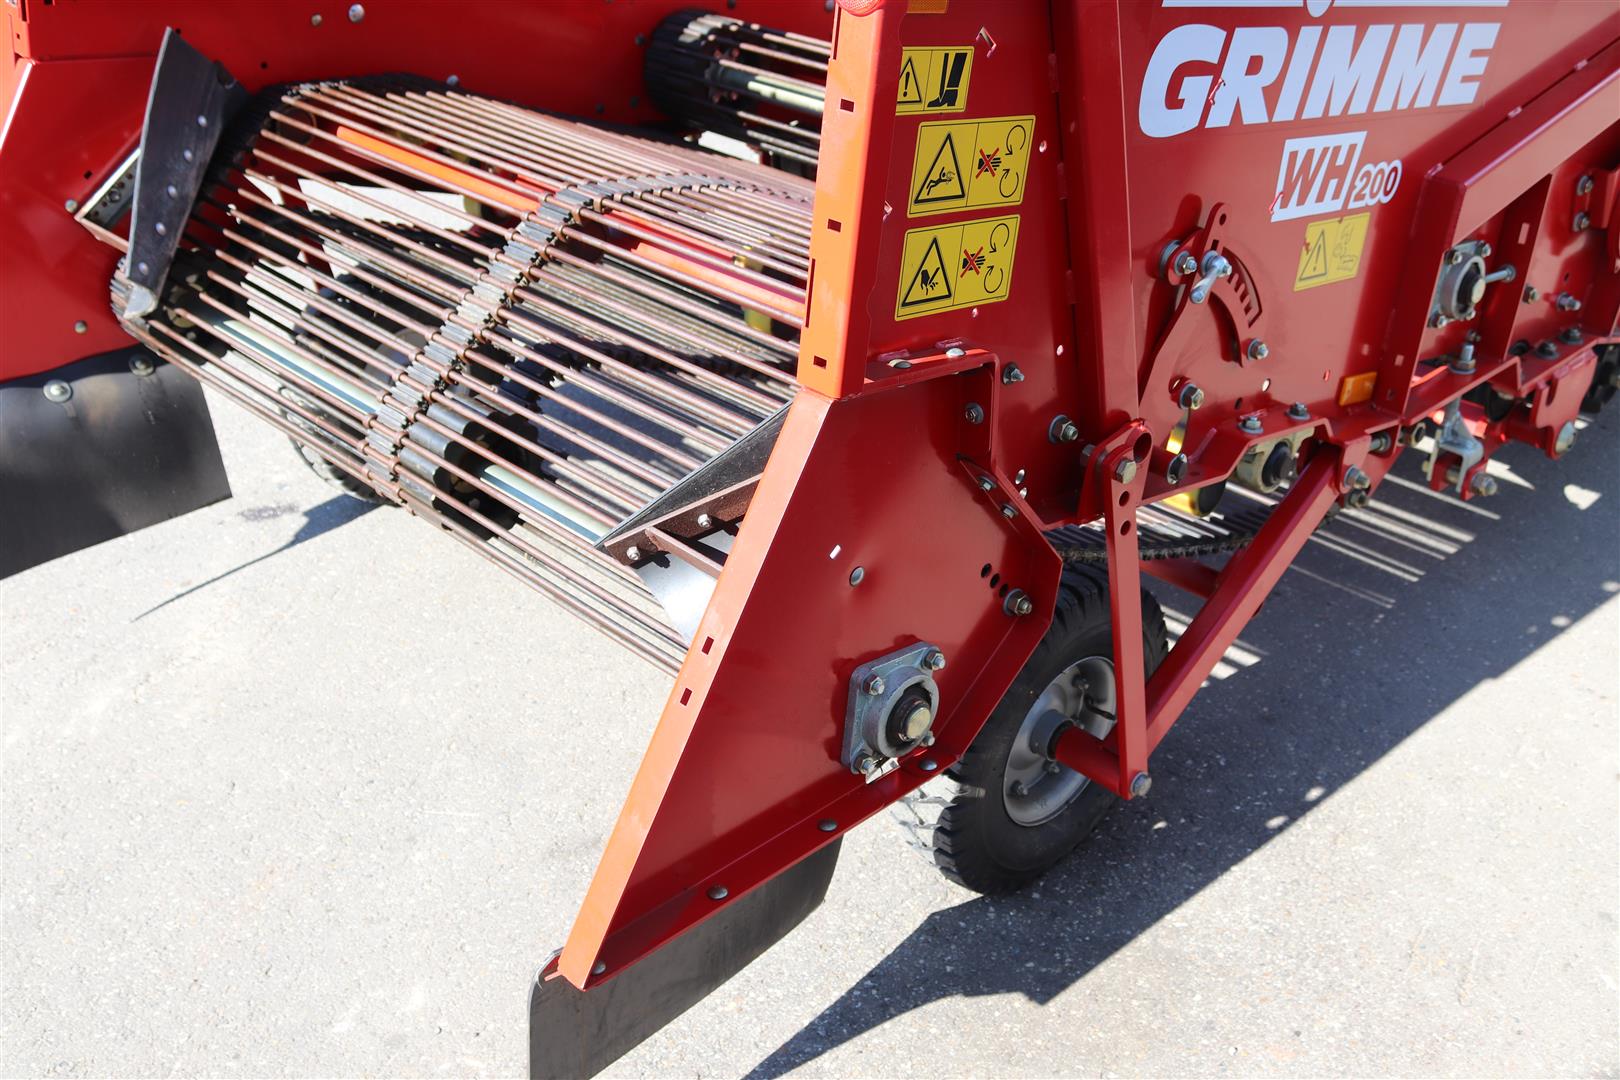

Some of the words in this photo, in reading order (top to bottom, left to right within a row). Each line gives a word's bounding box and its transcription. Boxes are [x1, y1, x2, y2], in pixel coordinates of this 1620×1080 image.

[1138, 22, 1502, 138] GRIMME
[1277, 140, 1360, 212] WH
[1348, 160, 1402, 209] 200
